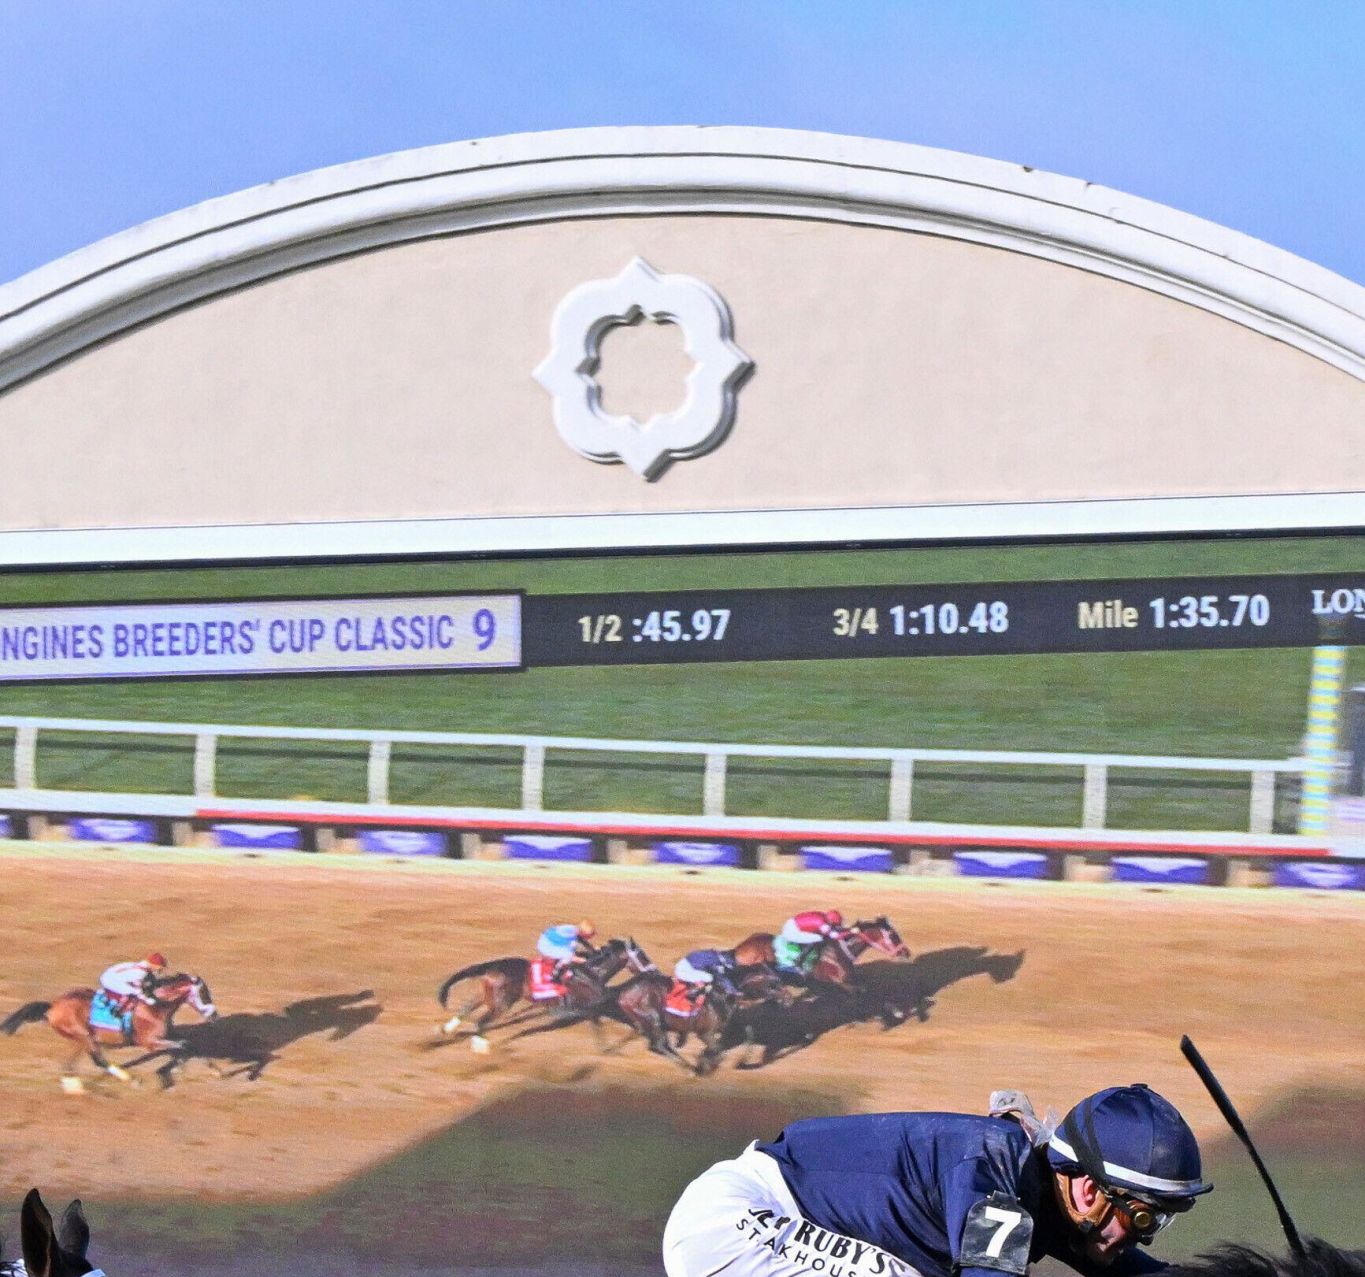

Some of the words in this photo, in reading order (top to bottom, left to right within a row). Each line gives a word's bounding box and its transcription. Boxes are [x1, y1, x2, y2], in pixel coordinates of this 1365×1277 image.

[113, 618, 261, 658] BREEDERS'
[268, 618, 326, 654] CUP
[333, 613, 456, 651] CLASSIC
[472, 608, 497, 651] 9
[577, 614, 624, 645] 1/2
[631, 608, 732, 643] :45.97
[832, 607, 879, 638] 3/4
[889, 600, 1010, 635] 1:10.48
[1077, 600, 1139, 630] Mile
[1149, 594, 1271, 630] 1:35.70
[794, 1220, 891, 1275] RUBY'S
[984, 1205, 1022, 1259] 7
